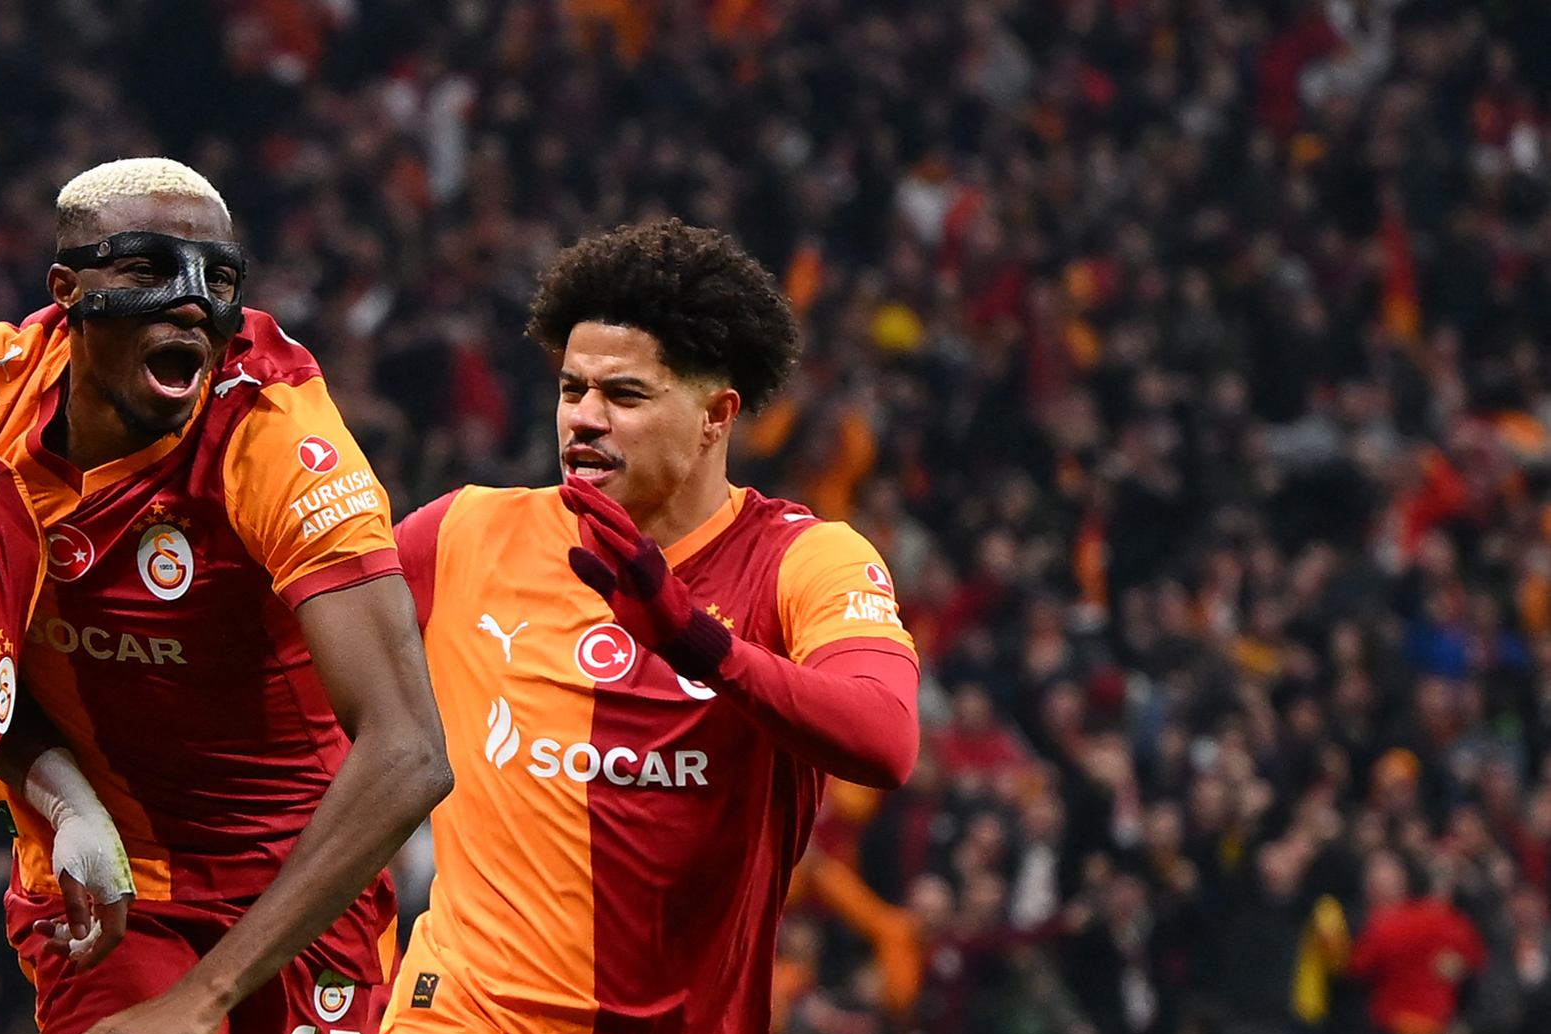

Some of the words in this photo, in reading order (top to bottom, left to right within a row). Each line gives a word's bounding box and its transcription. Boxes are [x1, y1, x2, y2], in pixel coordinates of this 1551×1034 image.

[289, 468, 373, 519] TURKISH
[302, 489, 379, 539] AIRLINES
[527, 738, 709, 787] SOCAR
